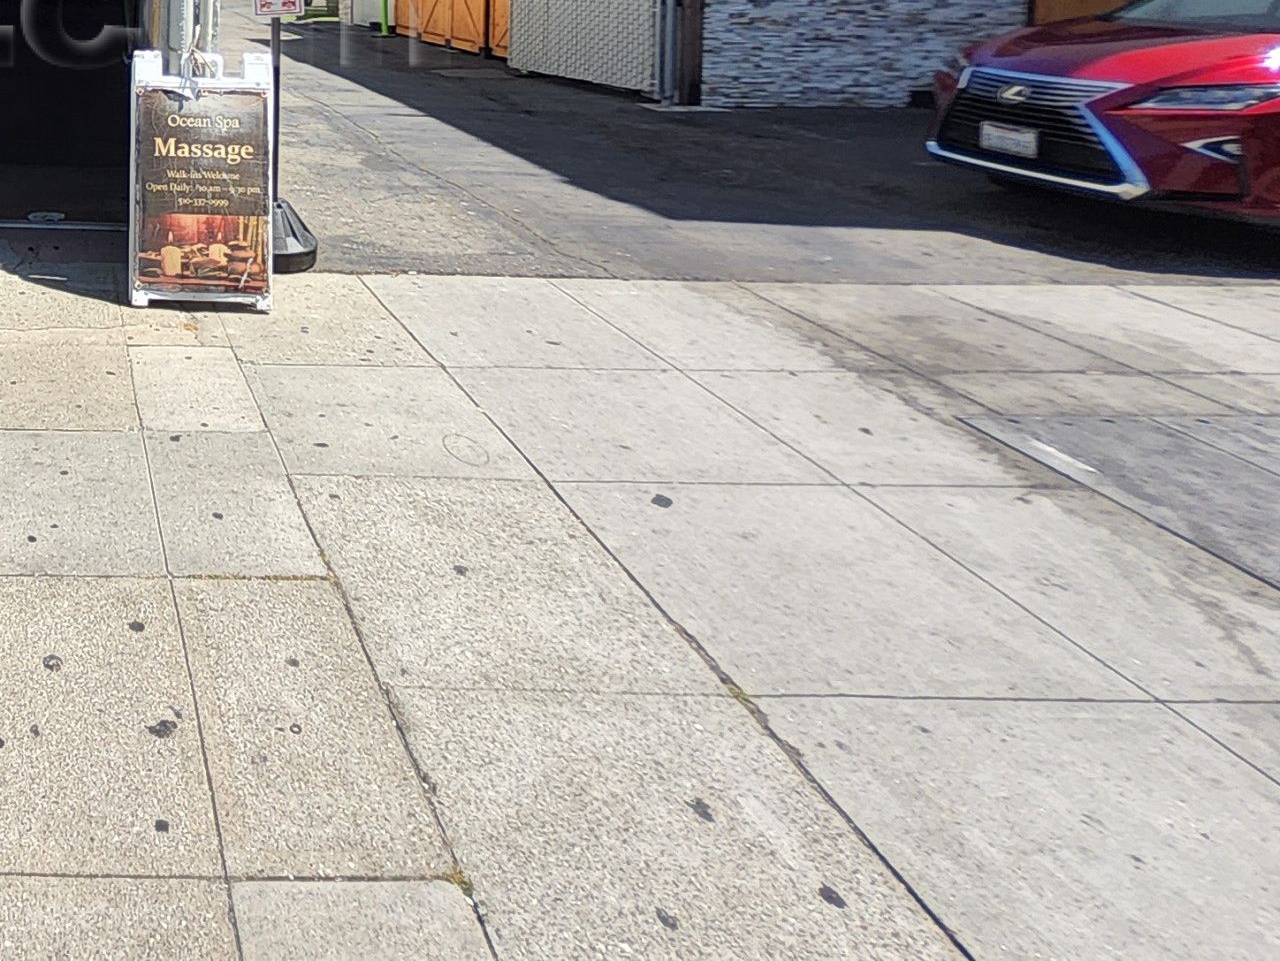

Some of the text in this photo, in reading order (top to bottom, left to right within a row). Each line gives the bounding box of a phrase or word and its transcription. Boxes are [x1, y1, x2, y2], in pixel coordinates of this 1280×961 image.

[167, 114, 240, 131] Ocean Spa
[153, 137, 254, 165] Massage
[145, 182, 168, 192] Open
[177, 199, 229, 208] 510-337-0999
